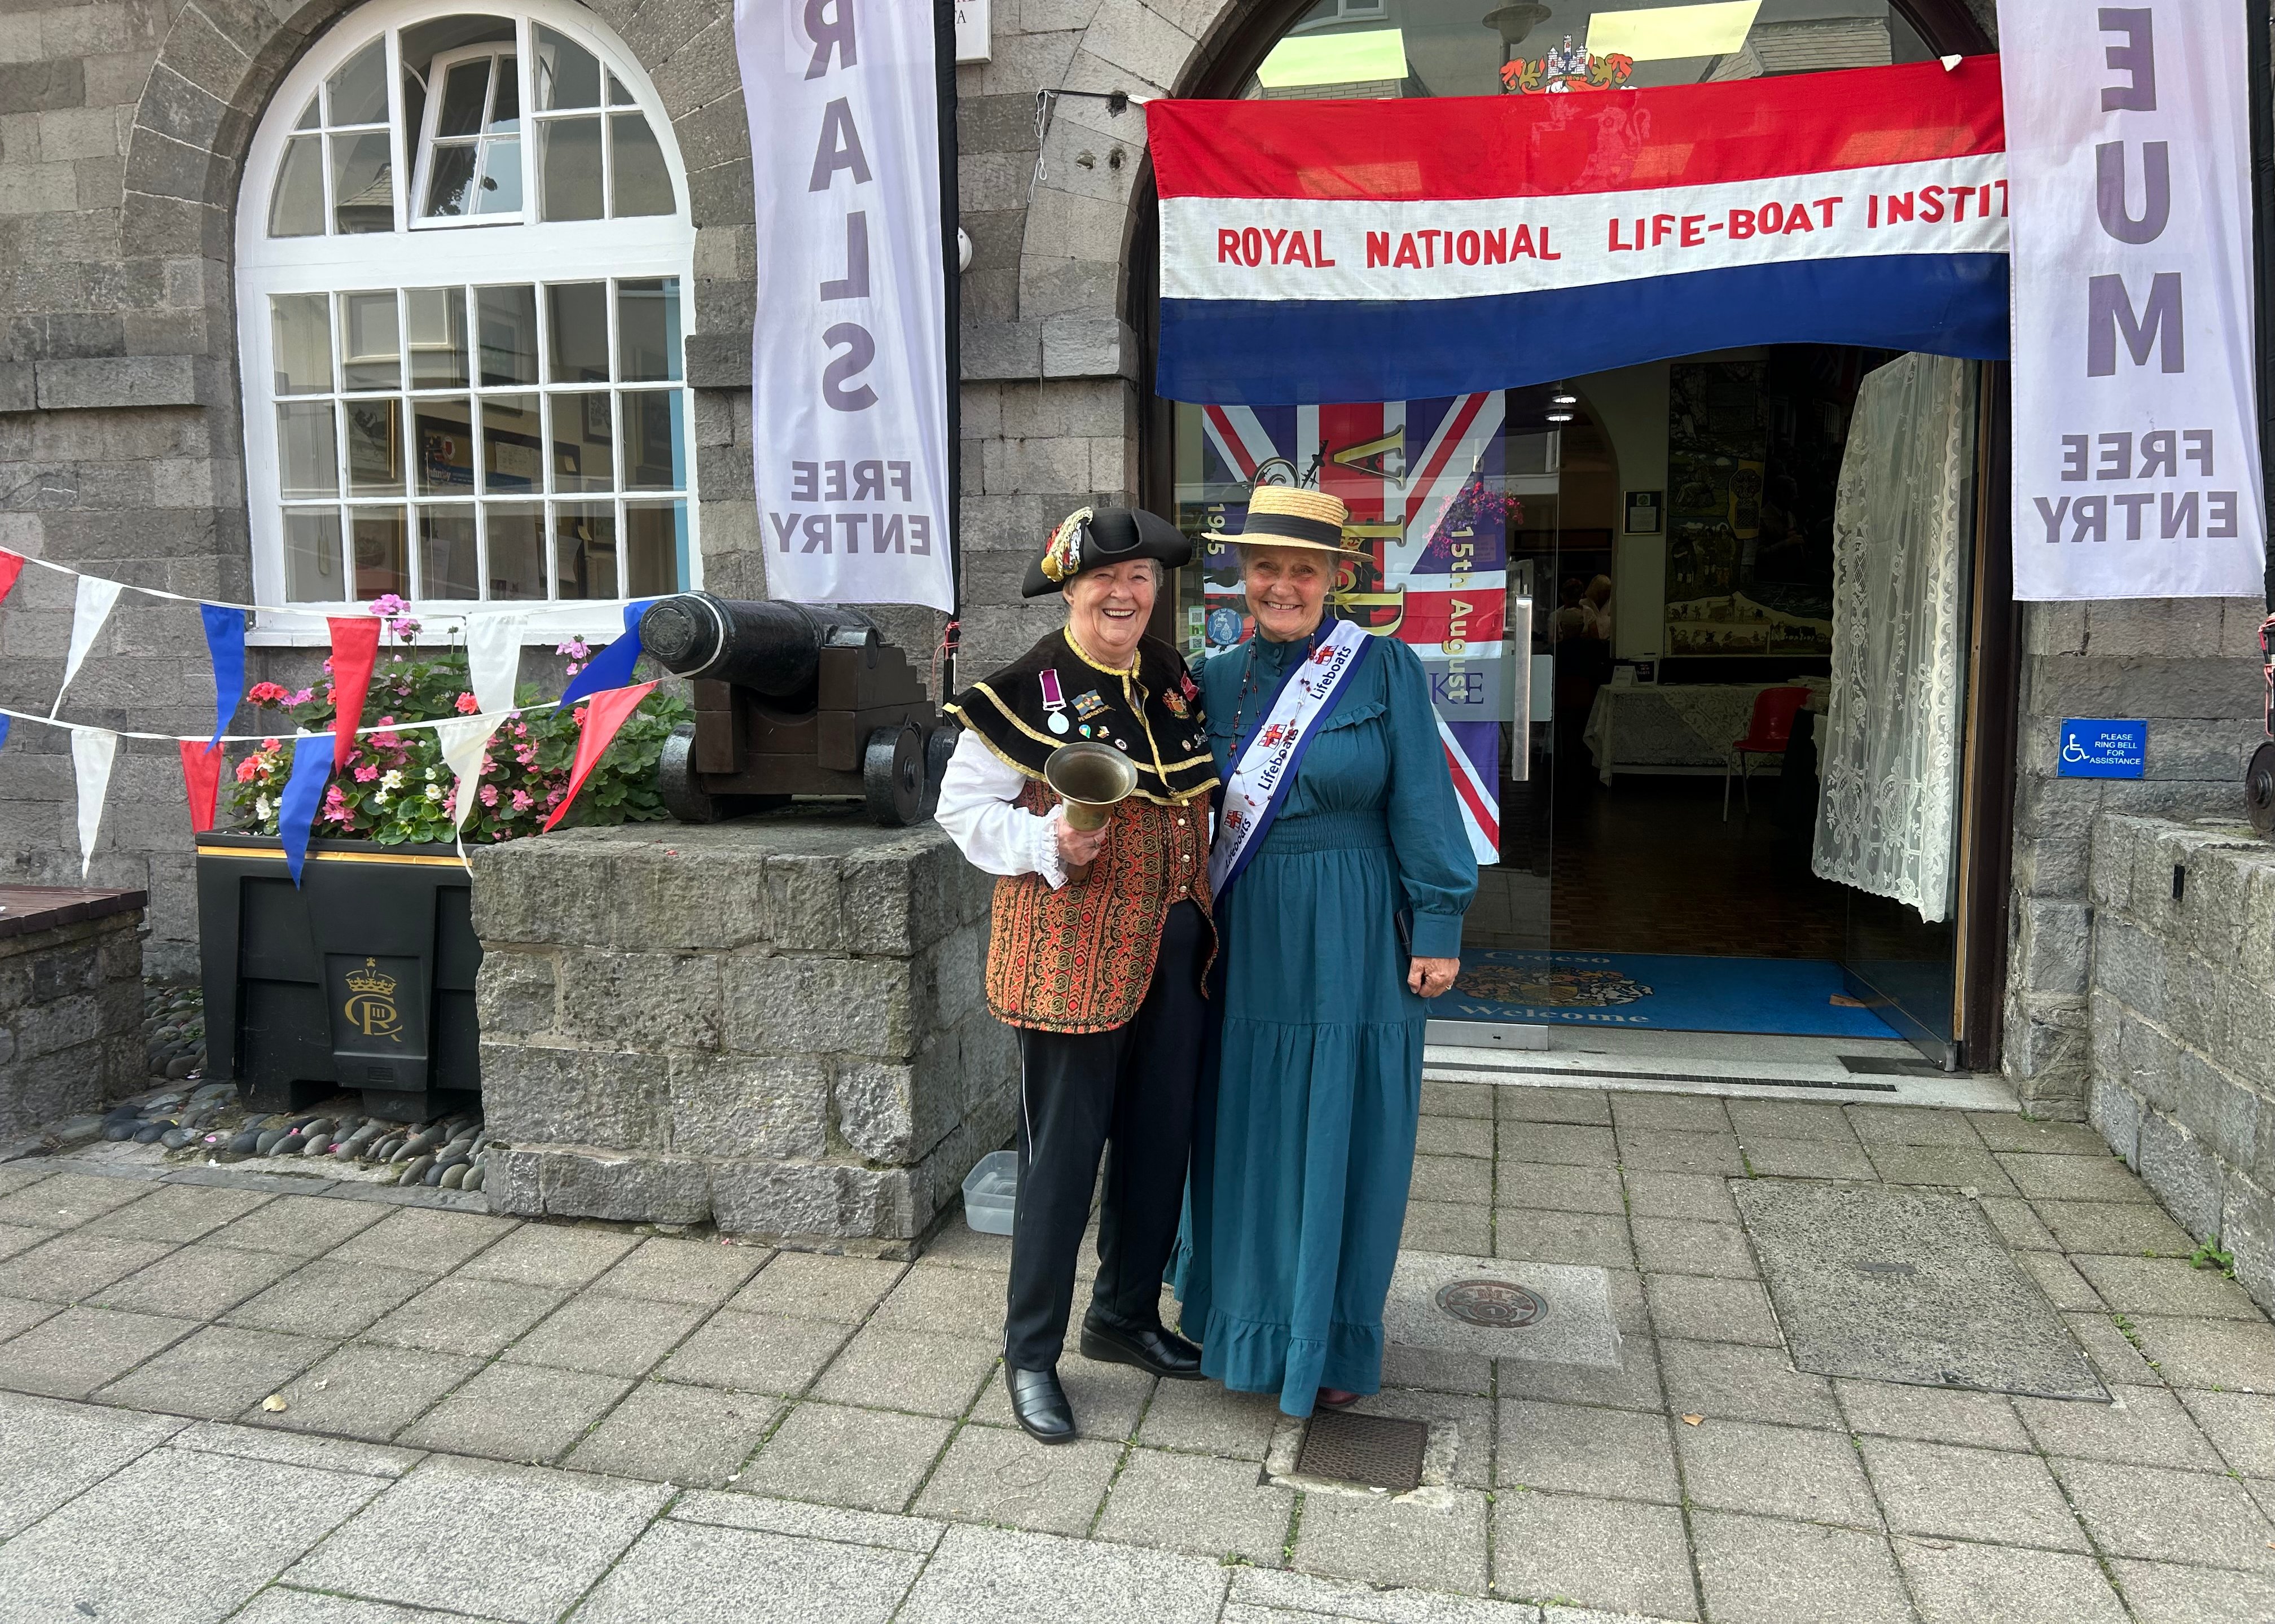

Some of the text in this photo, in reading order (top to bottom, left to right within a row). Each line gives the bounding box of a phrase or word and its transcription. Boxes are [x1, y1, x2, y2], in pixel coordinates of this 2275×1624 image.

[1218, 227, 1336, 267] ROYAL
[1366, 224, 1562, 269] NATIONAL
[1608, 196, 1843, 252] LIFE-BOAT
[1443, 526, 1474, 700] 15th August
[1310, 646, 1351, 700] Lifeboats
[2089, 757, 2141, 765] ASSISTANCE
[1226, 818, 1251, 870] Lifeboats
[1485, 951, 1611, 964] Croeso
[1458, 1004, 1650, 1023] Welcome
